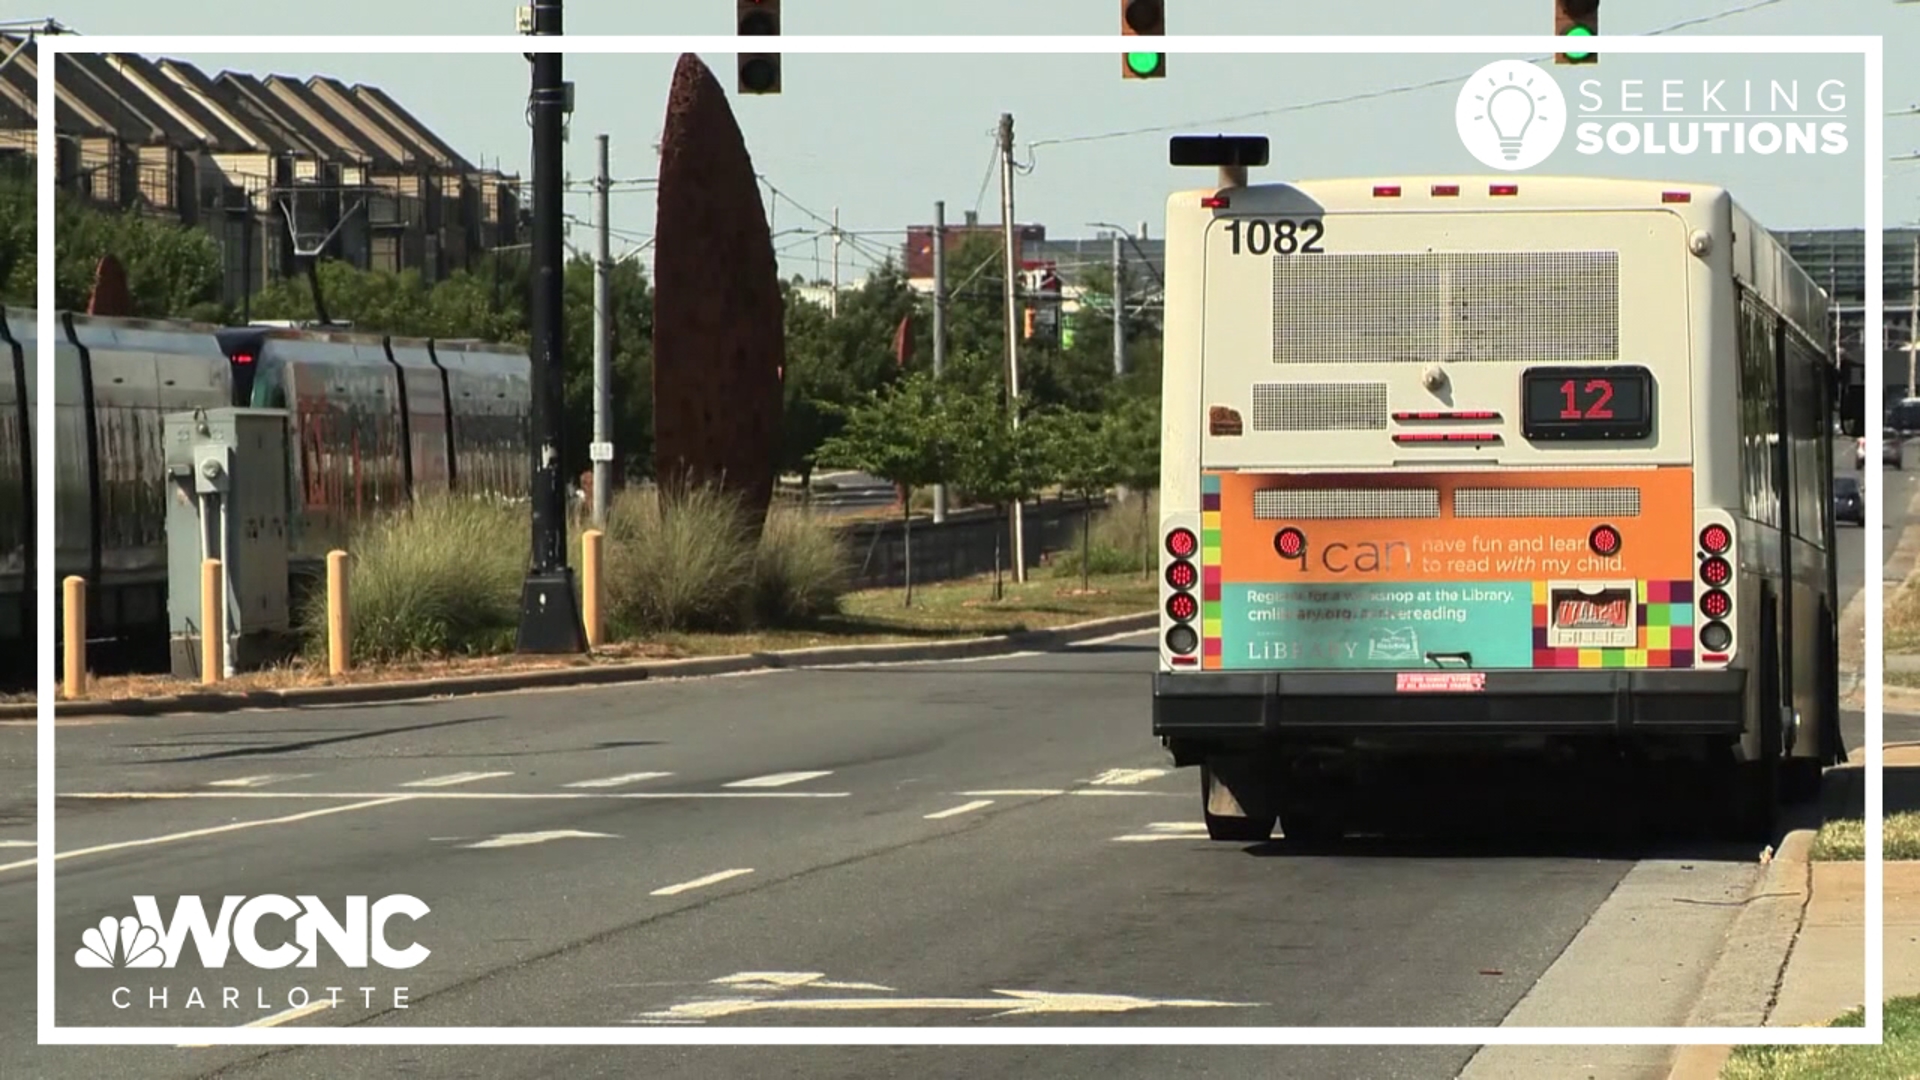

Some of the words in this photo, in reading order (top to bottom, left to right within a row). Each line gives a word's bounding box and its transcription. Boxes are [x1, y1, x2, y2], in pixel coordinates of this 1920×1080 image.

[1225, 219, 1325, 255] 1082
[1560, 380, 1614, 419] 12
[1472, 535, 1503, 552] fun
[1508, 535, 1543, 552] and
[1550, 535, 1590, 552] lear
[1322, 541, 1412, 573] can
[1422, 557, 1442, 573] to
[1447, 556, 1489, 572] read
[1496, 556, 1536, 572] with
[1542, 559, 1571, 575] my
[1577, 555, 1626, 572] child.
[1417, 591, 1432, 602] at
[1436, 589, 1458, 602] the
[1462, 589, 1514, 604] Library.
